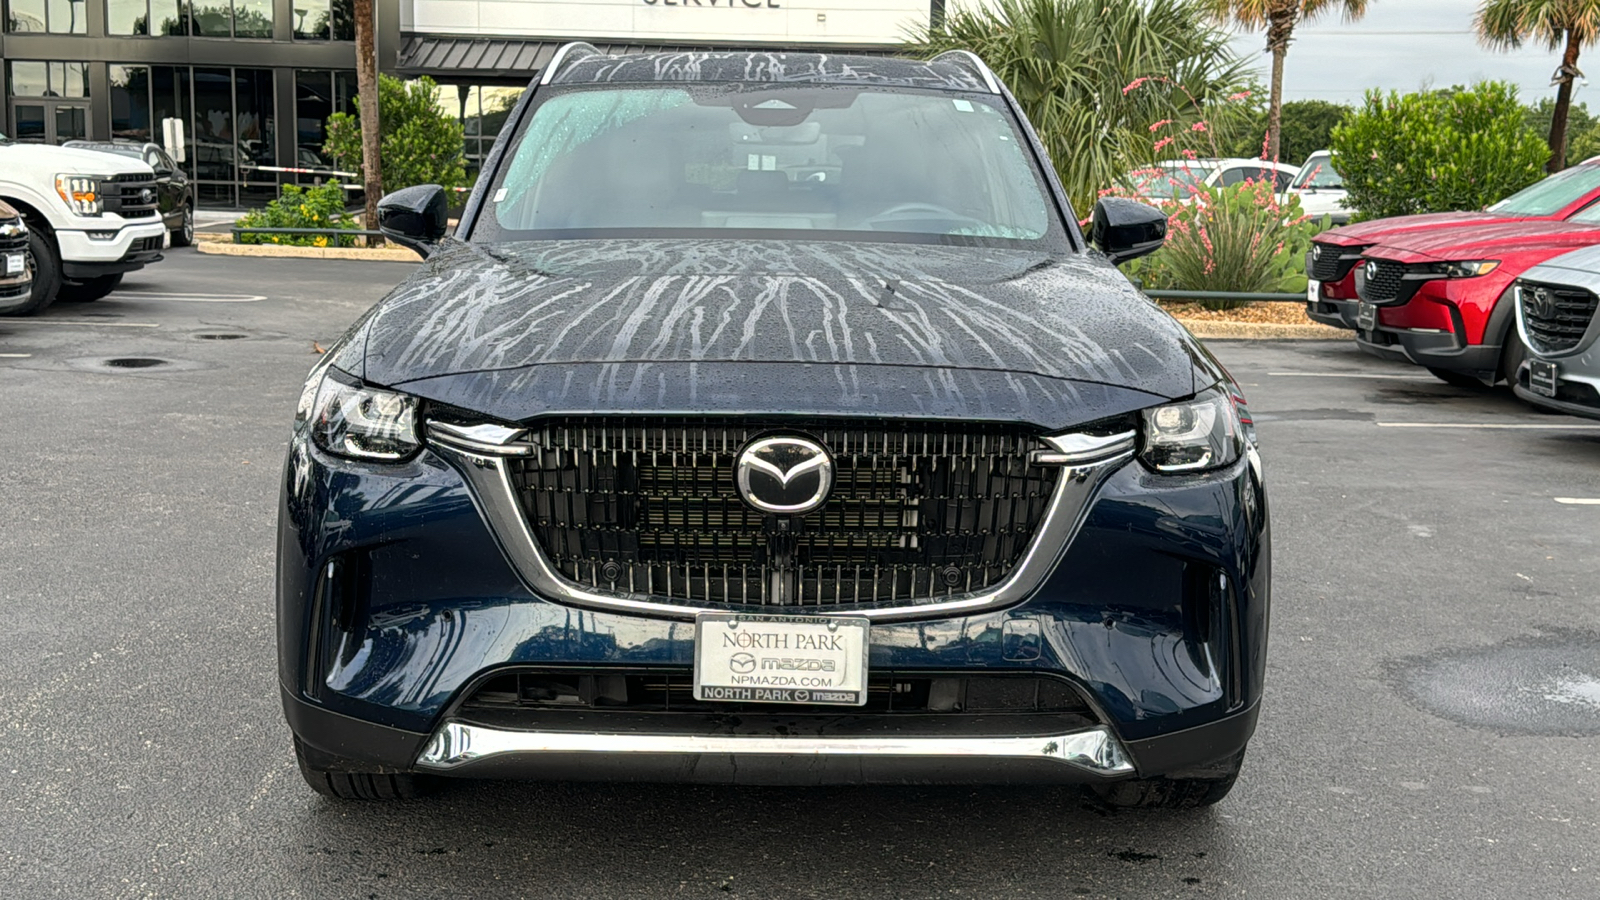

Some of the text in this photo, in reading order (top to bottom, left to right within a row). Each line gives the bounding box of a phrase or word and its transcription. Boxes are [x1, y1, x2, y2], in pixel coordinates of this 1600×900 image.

[769, 616, 828, 624] ANTONIO
[722, 630, 844, 651] NORTH PARK
[731, 675, 832, 687] NPMAZDA.COM
[704, 687, 751, 700] NORTH
[755, 689, 792, 701] PARK
